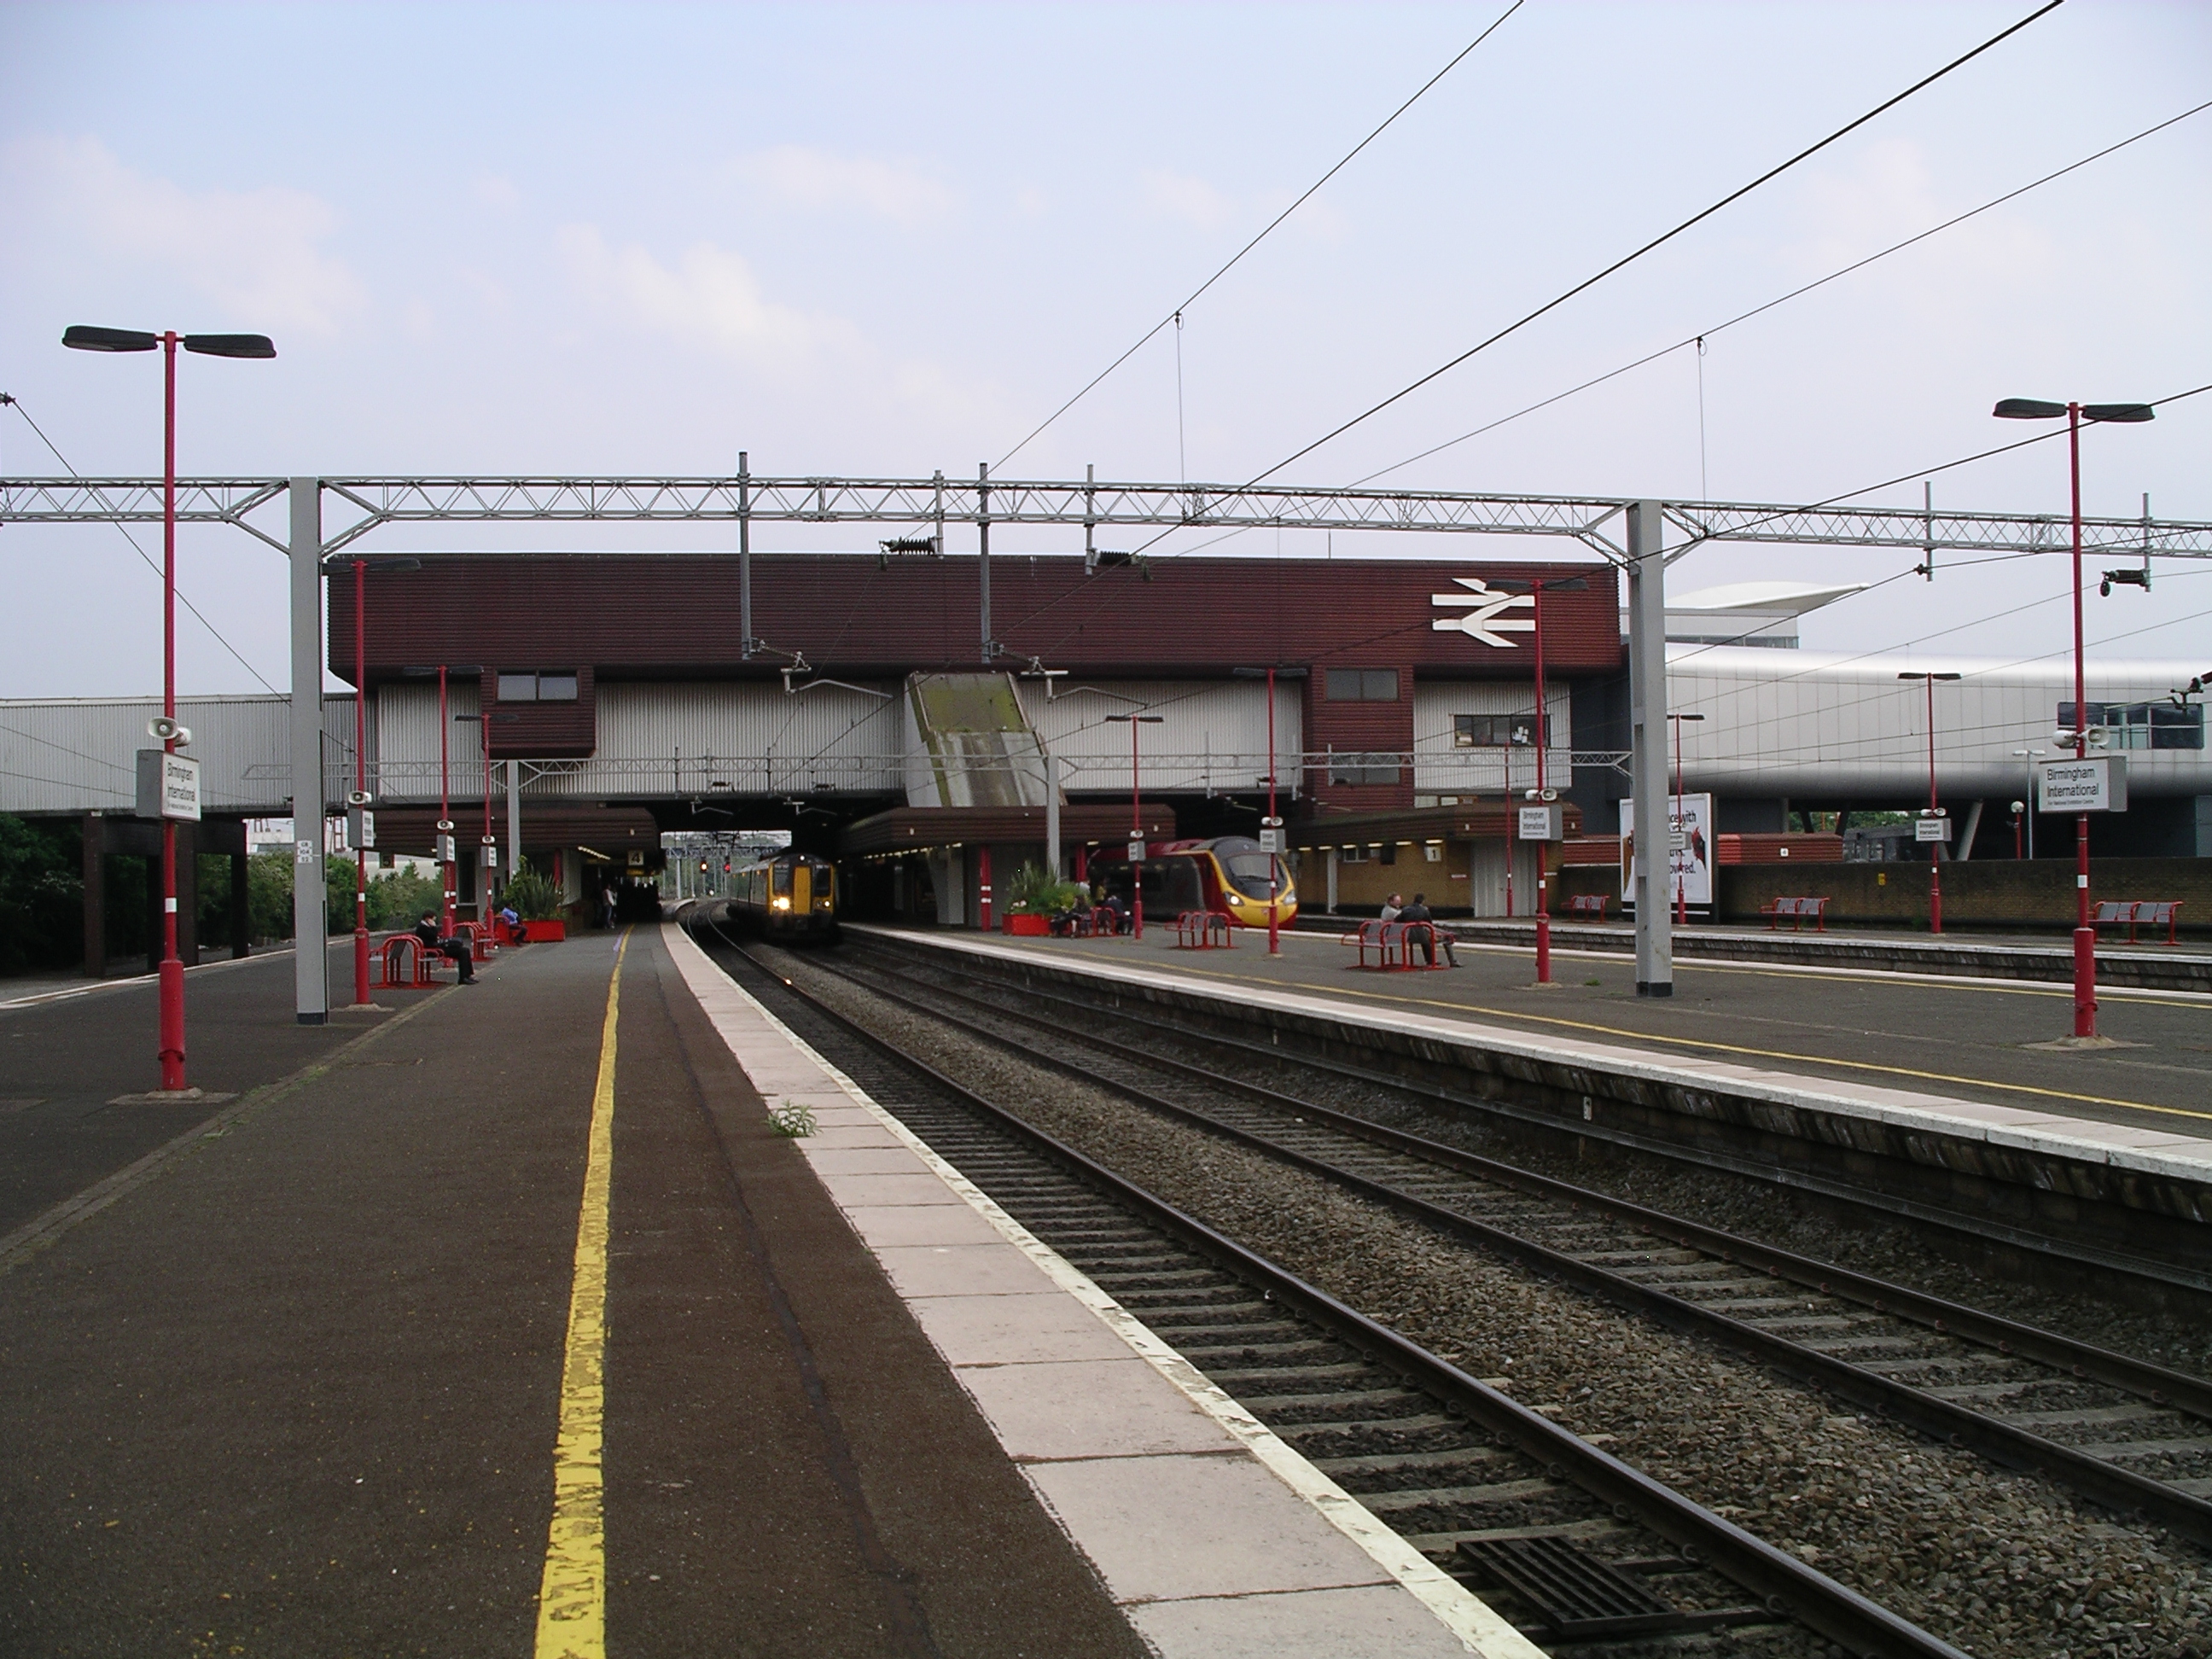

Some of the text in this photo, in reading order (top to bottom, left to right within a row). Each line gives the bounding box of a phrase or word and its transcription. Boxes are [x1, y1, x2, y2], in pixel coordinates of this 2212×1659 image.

[167, 761, 194, 783] Birmingham
[2047, 767, 2095, 782] Birmingham
[167, 783, 195, 802] International
[2047, 783, 2099, 798] International
[631, 853, 641, 864] 4
